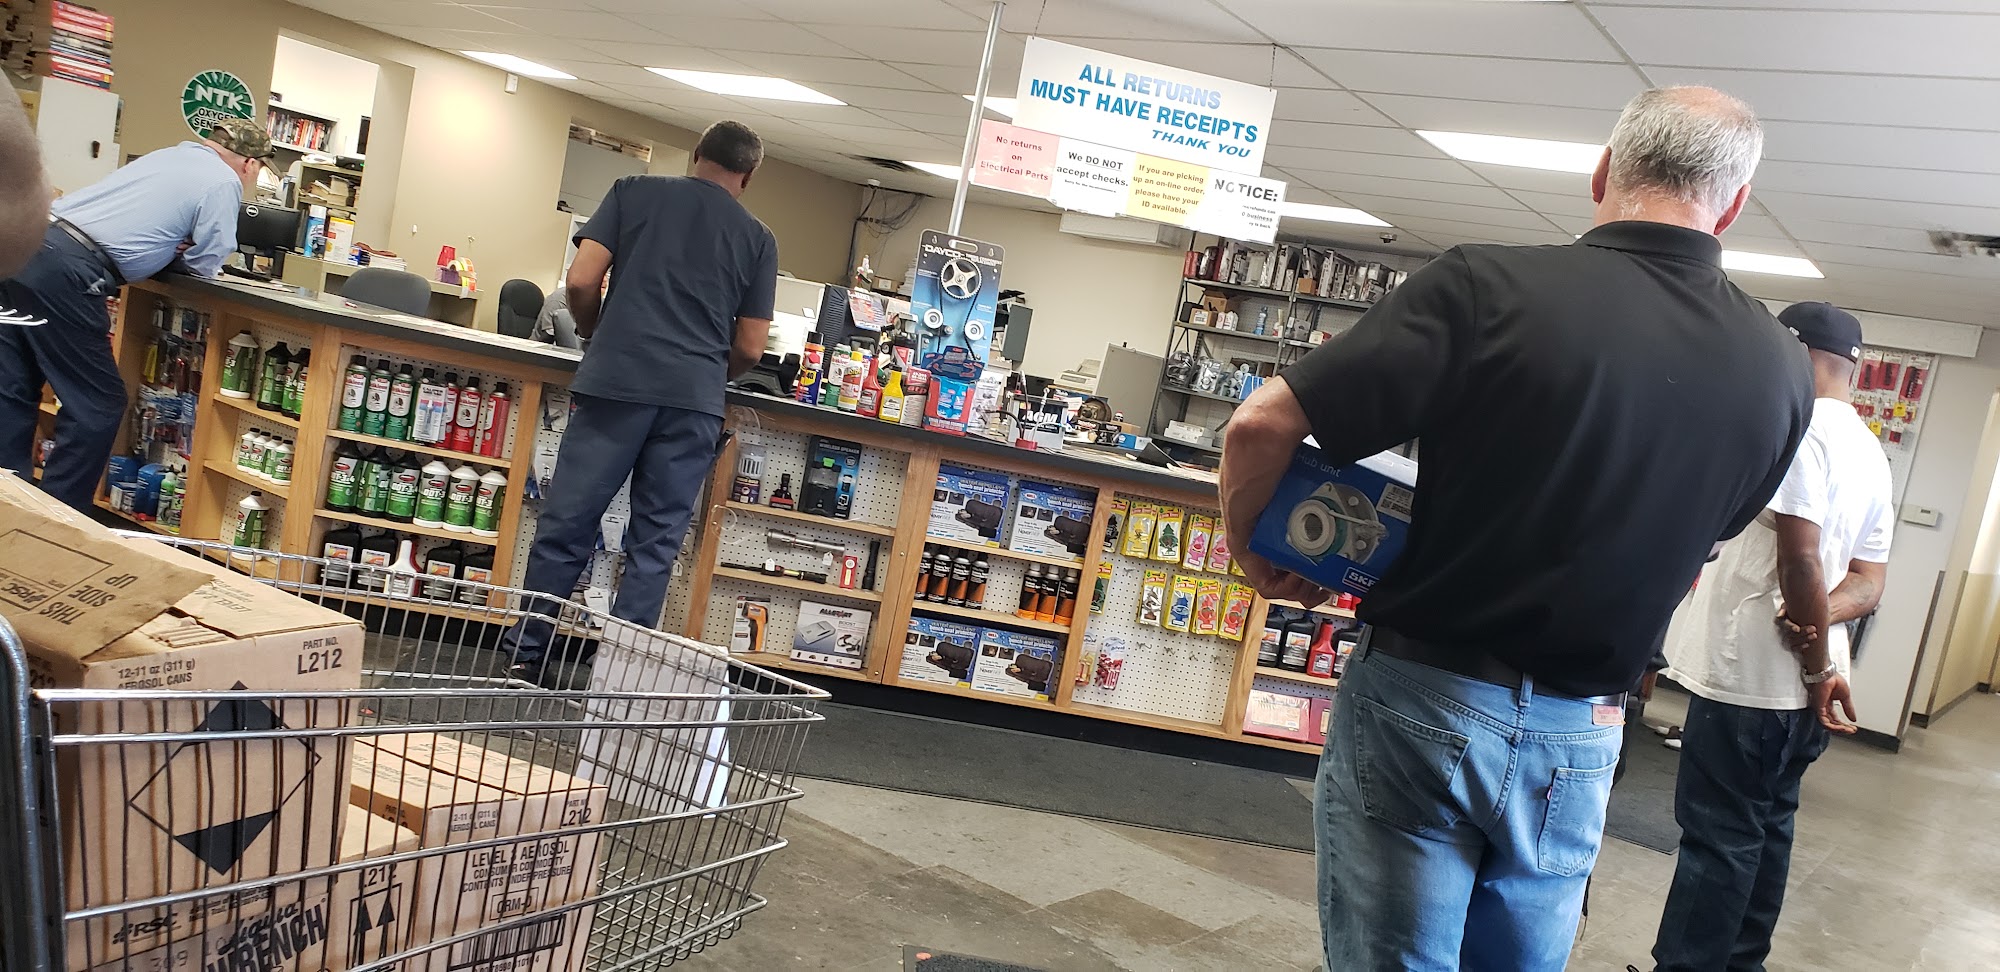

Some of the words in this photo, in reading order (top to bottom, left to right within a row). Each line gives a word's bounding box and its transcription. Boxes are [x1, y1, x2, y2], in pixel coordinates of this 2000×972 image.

[1079, 63, 1116, 88] ALL
[1123, 72, 1222, 110] RETURNS
[194, 83, 244, 111] NTK
[1030, 79, 1091, 107] MUST
[1095, 93, 1152, 120] HAVE
[1156, 105, 1258, 143] RECEIPTS
[996, 135, 1008, 144] No
[1011, 139, 1043, 152] returns
[1151, 129, 1211, 150] THANK
[1217, 143, 1251, 158] YOU
[1068, 151, 1083, 162] We
[1085, 155, 1100, 165] DO
[1102, 159, 1124, 170] NOT
[980, 160, 1023, 175] Electrical
[1025, 170, 1049, 181] Parts
[1056, 165, 1089, 179] accept
[1091, 170, 1129, 187] checks.
[1145, 166, 1160, 175] you
[1176, 172, 1204, 184] picking
[1133, 175, 1143, 183] up
[1156, 180, 1181, 190] on-line
[1214, 178, 1279, 202] NOTICE:
[1135, 188, 1160, 198] please
[1162, 193, 1181, 202] have
[1182, 197, 1200, 206] your
[1141, 200, 1150, 208] ID
[1151, 203, 1188, 215] available.
[922, 244, 965, 258] DAYCO
[1022, 410, 1059, 424] AGM
[104, 573, 139, 589] UP
[1348, 571, 1376, 587] SKF
[67, 584, 117, 607] SIDE
[39, 601, 86, 625] THIS
[302, 639, 323, 650] PART
[324, 636, 339, 648] NO.
[118, 665, 147, 679] 12-11
[149, 665, 161, 675] oz
[163, 660, 181, 675] (311
[183, 658, 196, 672] g)
[297, 648, 343, 675] L212
[167, 672, 193, 687] CANS
